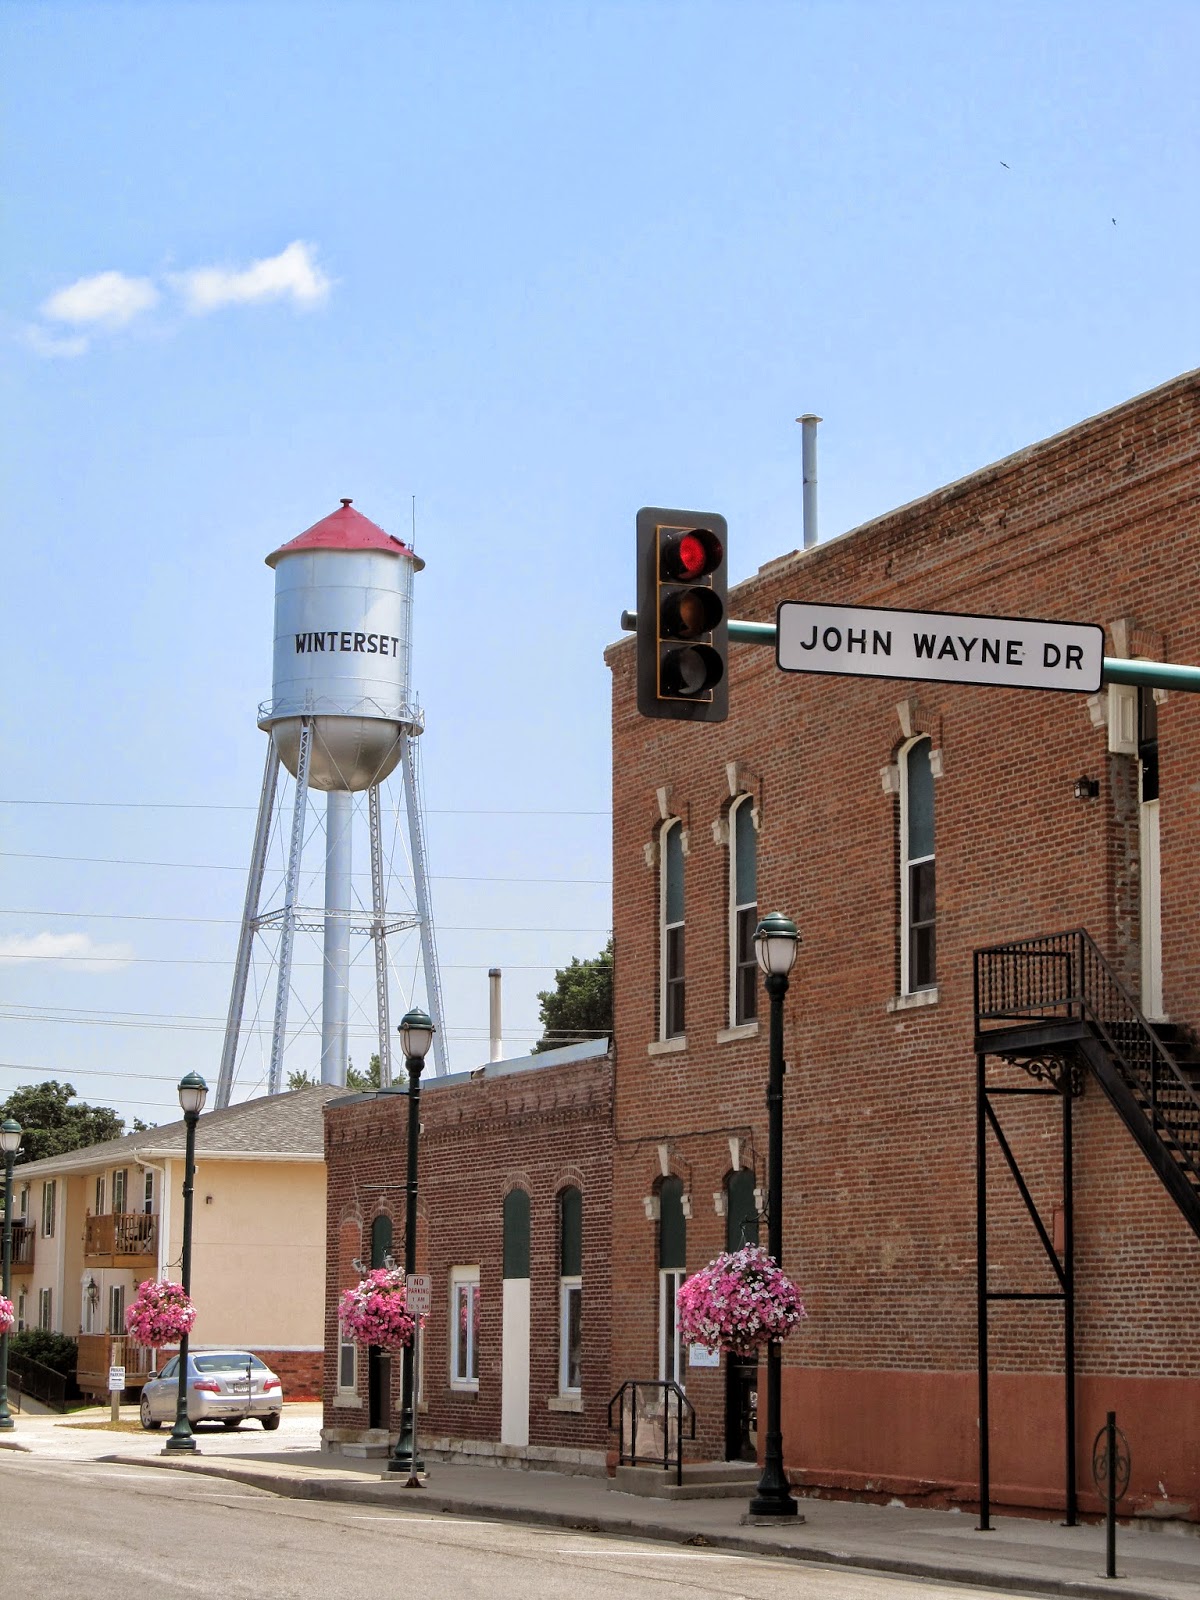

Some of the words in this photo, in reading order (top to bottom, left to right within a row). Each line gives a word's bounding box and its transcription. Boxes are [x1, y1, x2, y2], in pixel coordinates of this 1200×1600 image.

[295, 632, 399, 657] WINTERSET
[800, 626, 892, 656] JOHN
[913, 633, 1023, 665] WAYNE
[1043, 643, 1083, 670] DR
[413, 1278, 424, 1286] NO
